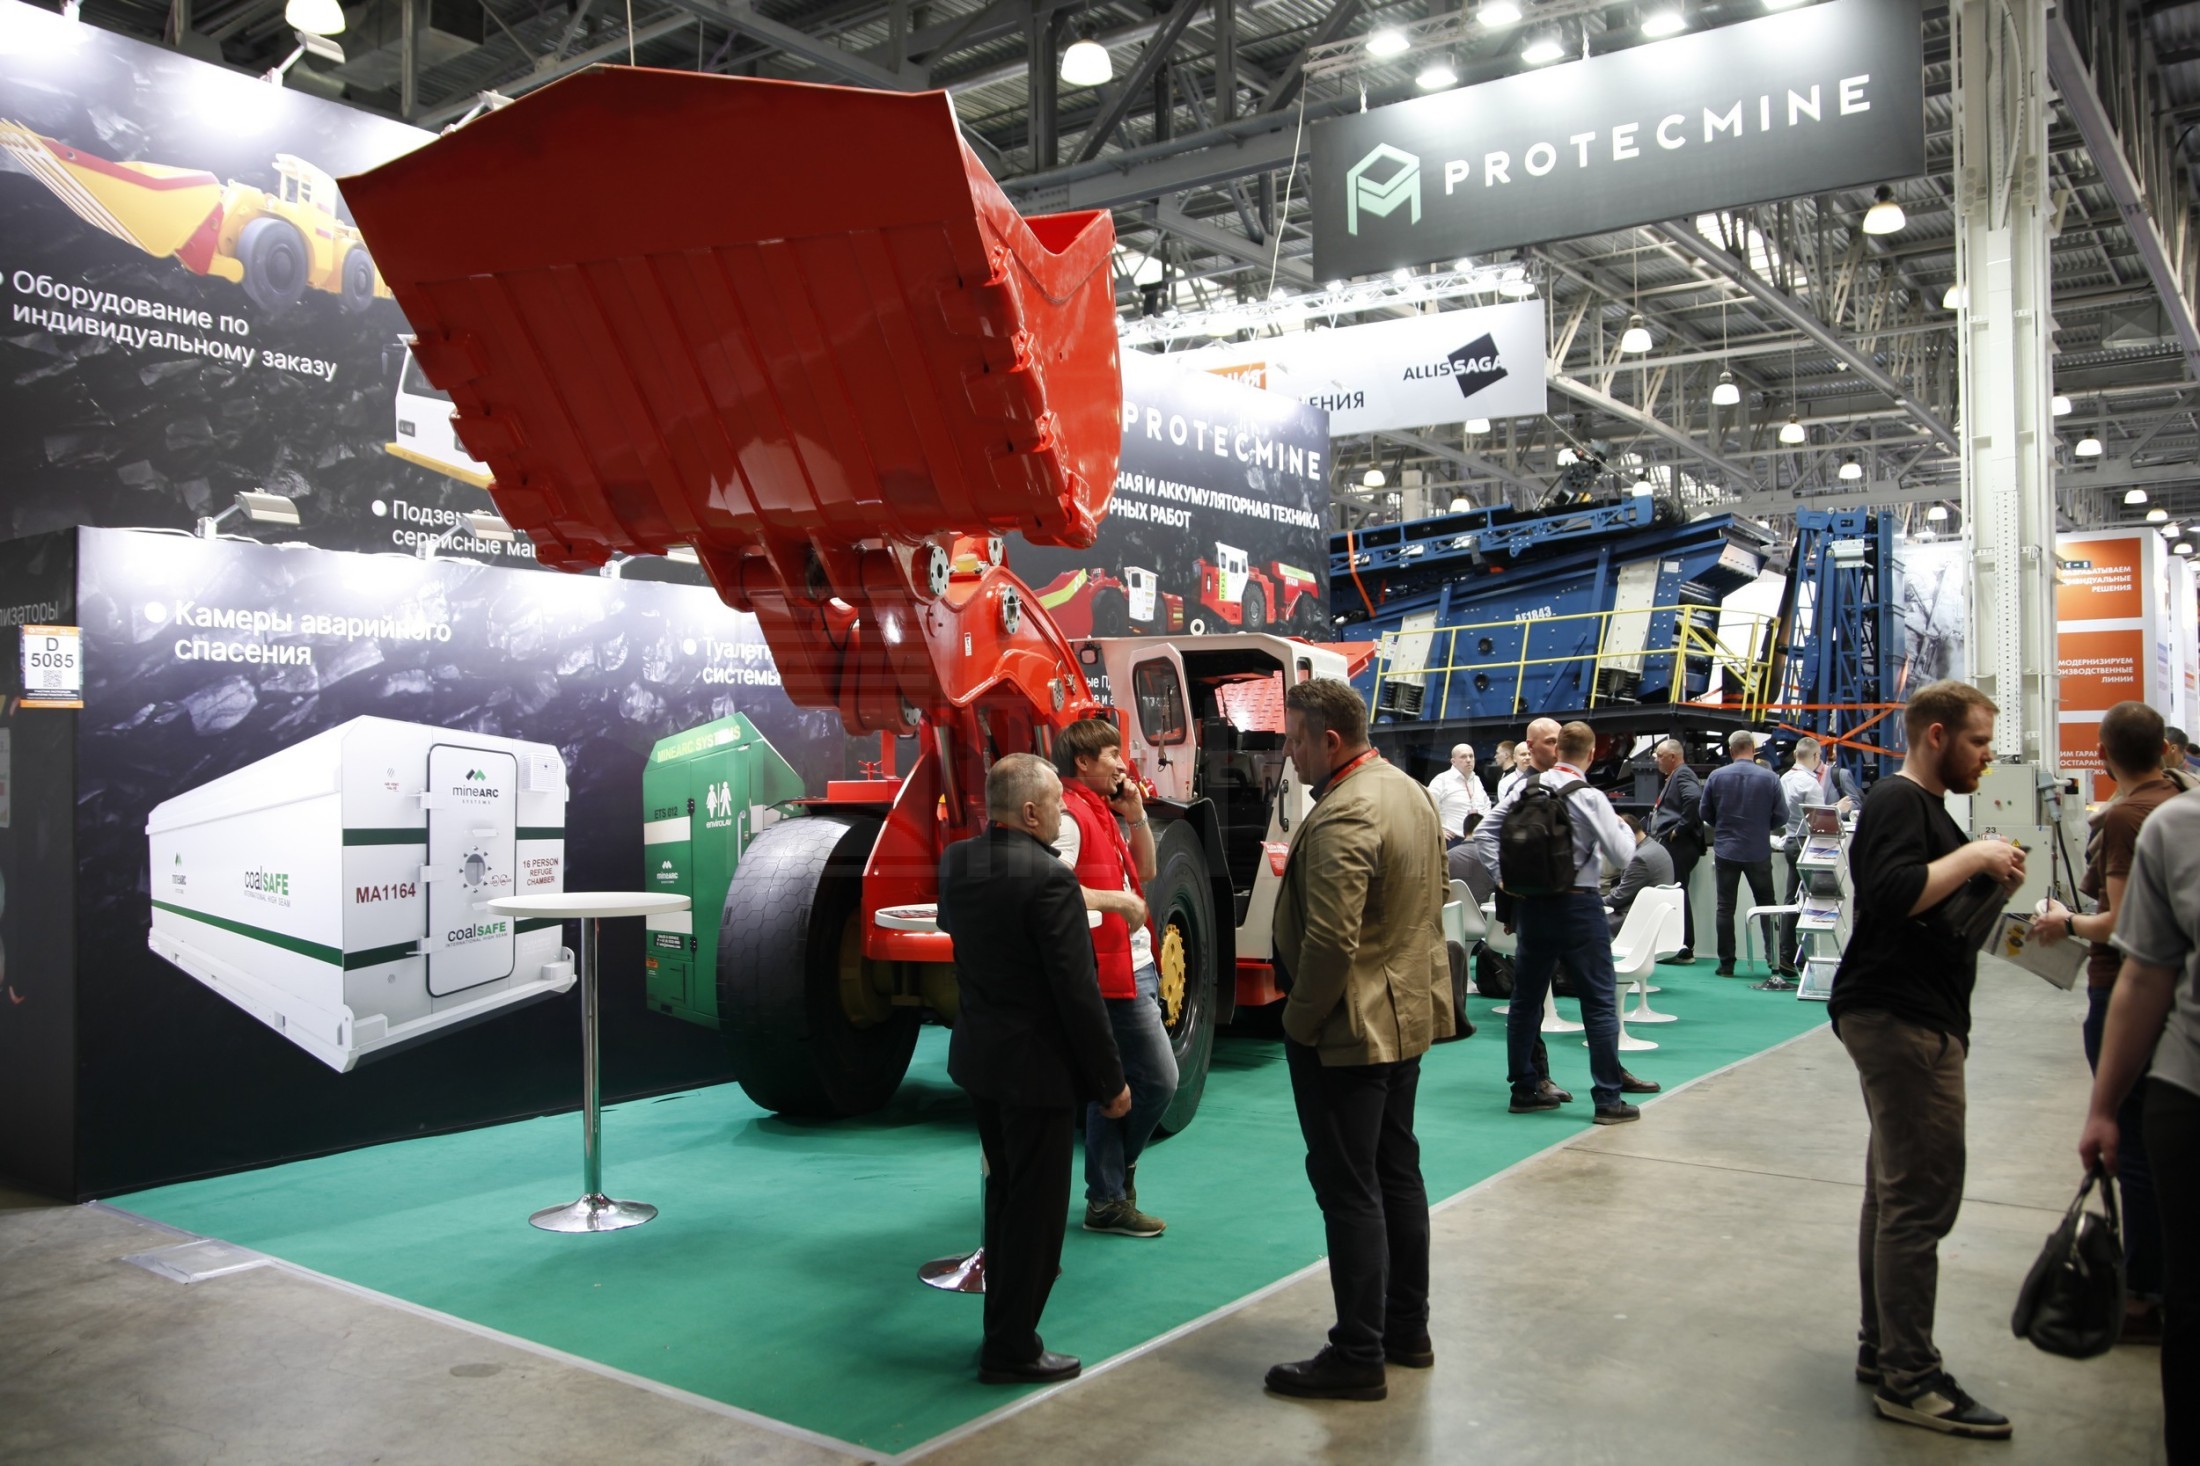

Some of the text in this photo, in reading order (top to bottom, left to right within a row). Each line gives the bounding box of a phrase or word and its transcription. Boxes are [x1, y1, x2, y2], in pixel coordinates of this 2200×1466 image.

[1444, 73, 1872, 196] PROTECMINE
[13, 270, 250, 336] Оборудование по
[13, 303, 338, 382] индивидуальному заказу
[1122, 400, 1321, 481] PROTECMINE
[1145, 476, 1155, 496] И
[1157, 480, 1270, 519] АККУМУЛЯТОРНАЯ
[1271, 504, 1320, 530] ТЕХНИКА
[1150, 504, 1192, 528] РАБОТ
[2091, 584, 2132, 592] РЕШЕНИЯ
[175, 600, 451, 642] Камеры аварийного
[46, 637, 59, 652] D
[175, 638, 312, 666] спасения
[31, 653, 74, 668] 5085
[2058, 657, 2133, 666] МОДЕРНИЗИРУЕМ
[702, 667, 781, 685] системы
[657, 740, 694, 763] MINEARC
[452, 785, 499, 798] mineARC
[523, 857, 559, 869] 16 PERSON
[529, 868, 553, 877] REFUGE
[245, 865, 289, 896] coalSAFE
[526, 876, 555, 887] CHAMBER
[356, 882, 416, 904] MA1164
[447, 921, 506, 942] coalSAFE
